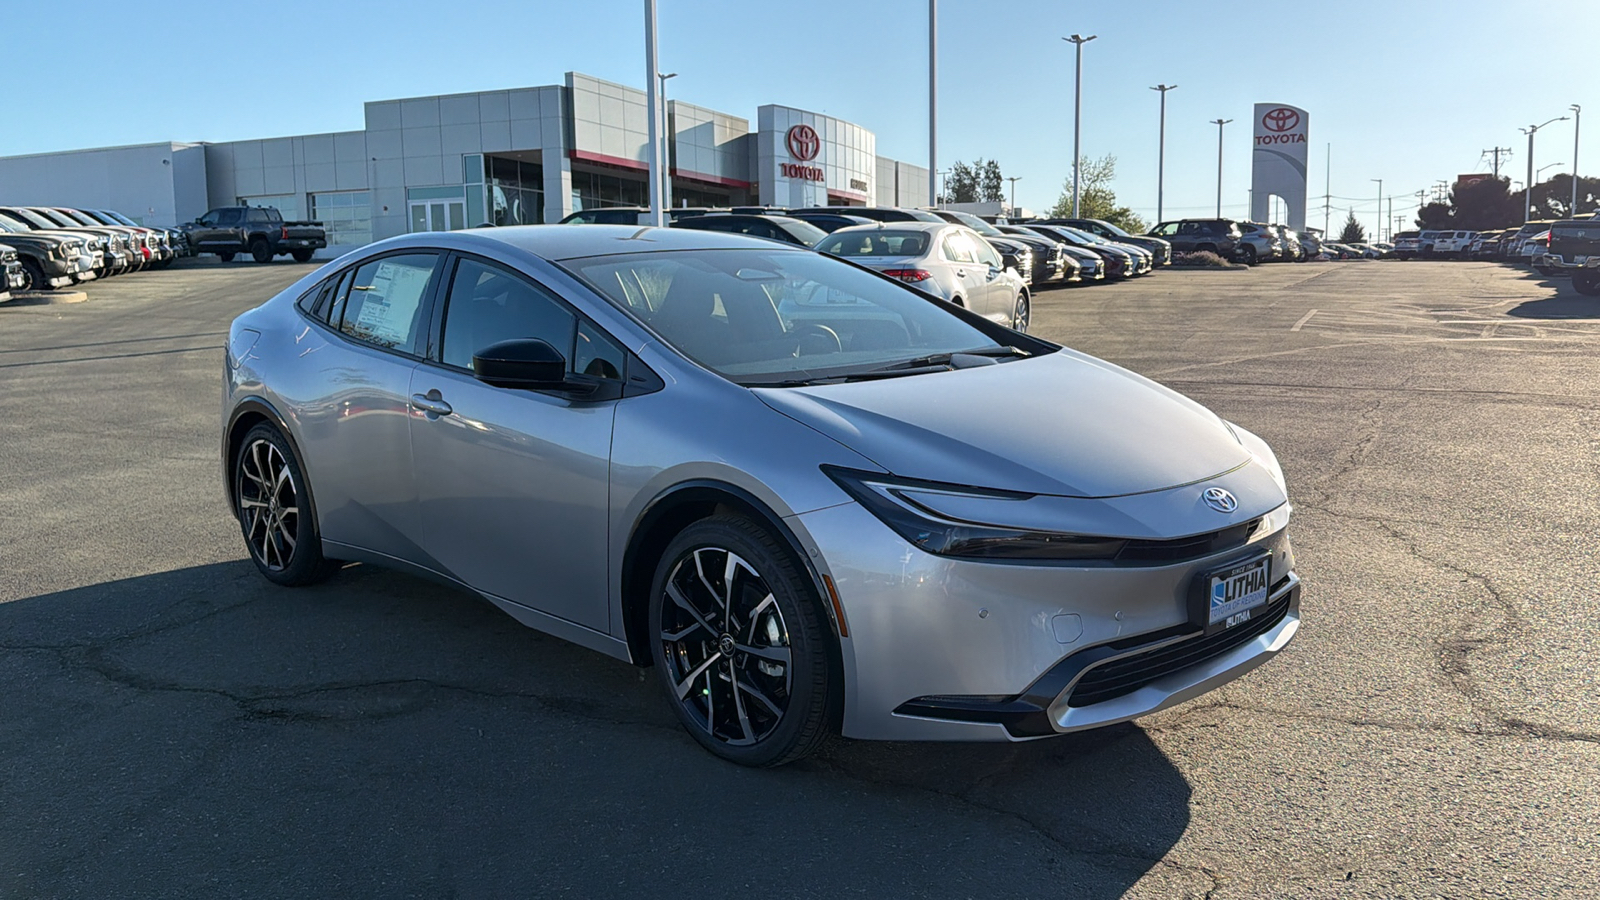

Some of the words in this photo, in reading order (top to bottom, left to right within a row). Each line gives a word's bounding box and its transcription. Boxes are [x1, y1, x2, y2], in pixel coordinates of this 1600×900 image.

[1255, 133, 1306, 145] TOYOTA
[781, 163, 824, 182] TOYOTA
[1231, 565, 1246, 576] SINCE
[1225, 568, 1266, 602] LITHIA
[1211, 602, 1232, 617] TOYOTA
[1232, 599, 1240, 610] OF
[1241, 589, 1266, 607] REDDING
[1231, 609, 1251, 626] LITHIA
